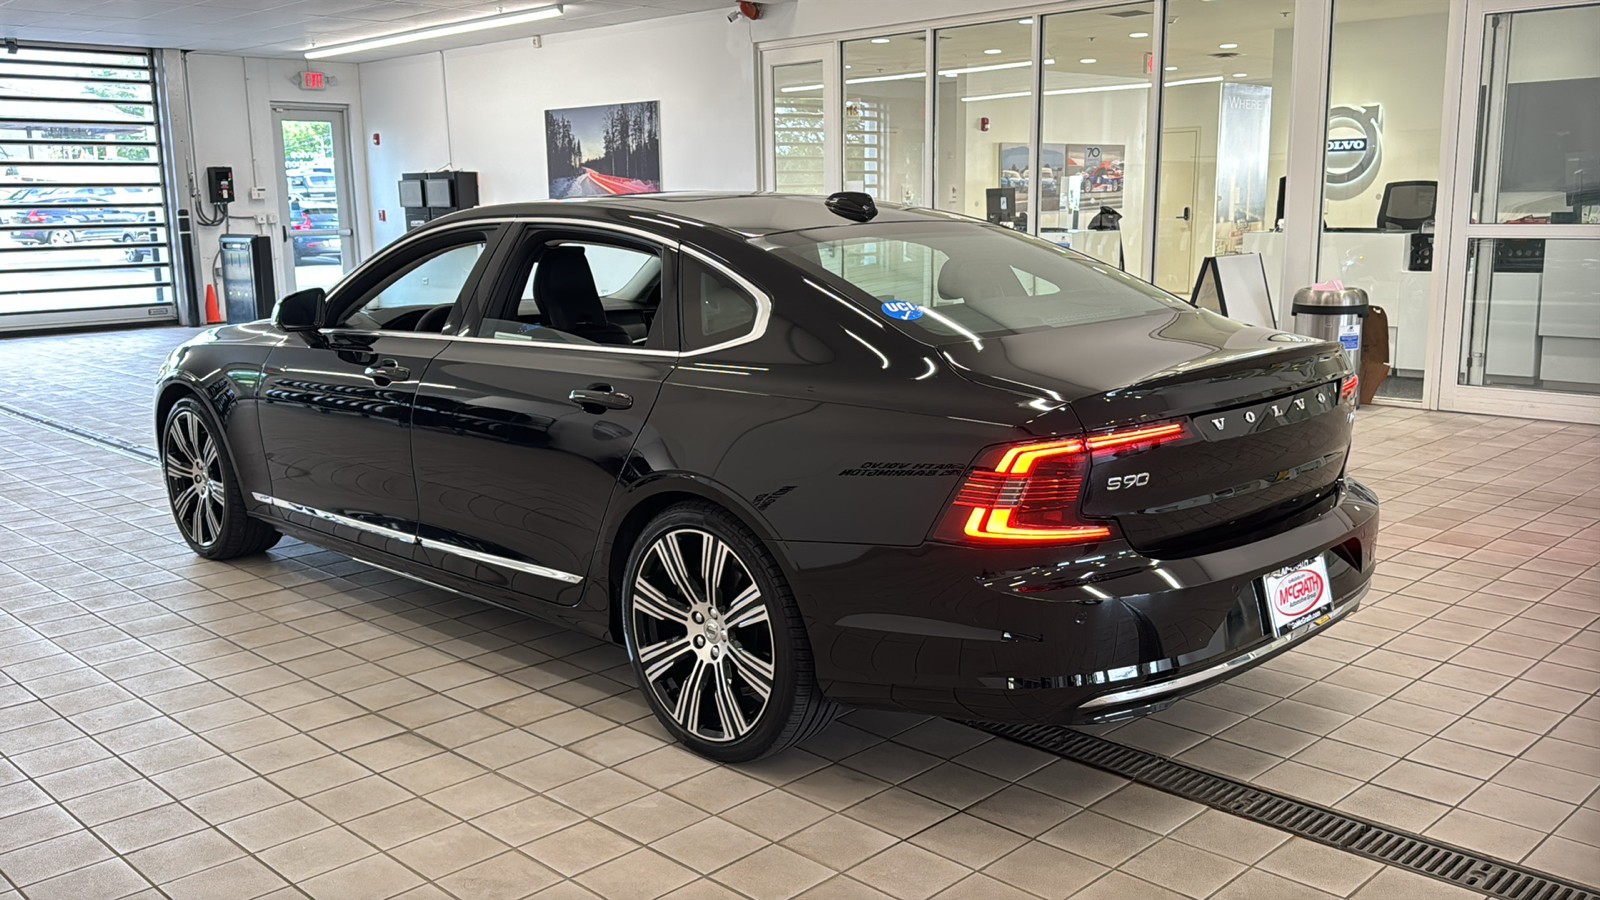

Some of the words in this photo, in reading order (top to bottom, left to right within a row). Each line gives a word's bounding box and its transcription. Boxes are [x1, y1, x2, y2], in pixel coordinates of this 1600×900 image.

[305, 72, 322, 87] EXIT
[1087, 147, 1101, 158] 70
[1328, 140, 1365, 150] OLVO
[884, 301, 916, 313] UCI
[1211, 393, 1326, 431] VOLVO
[1106, 472, 1150, 491] S90
[1279, 575, 1319, 606] McGRATH
